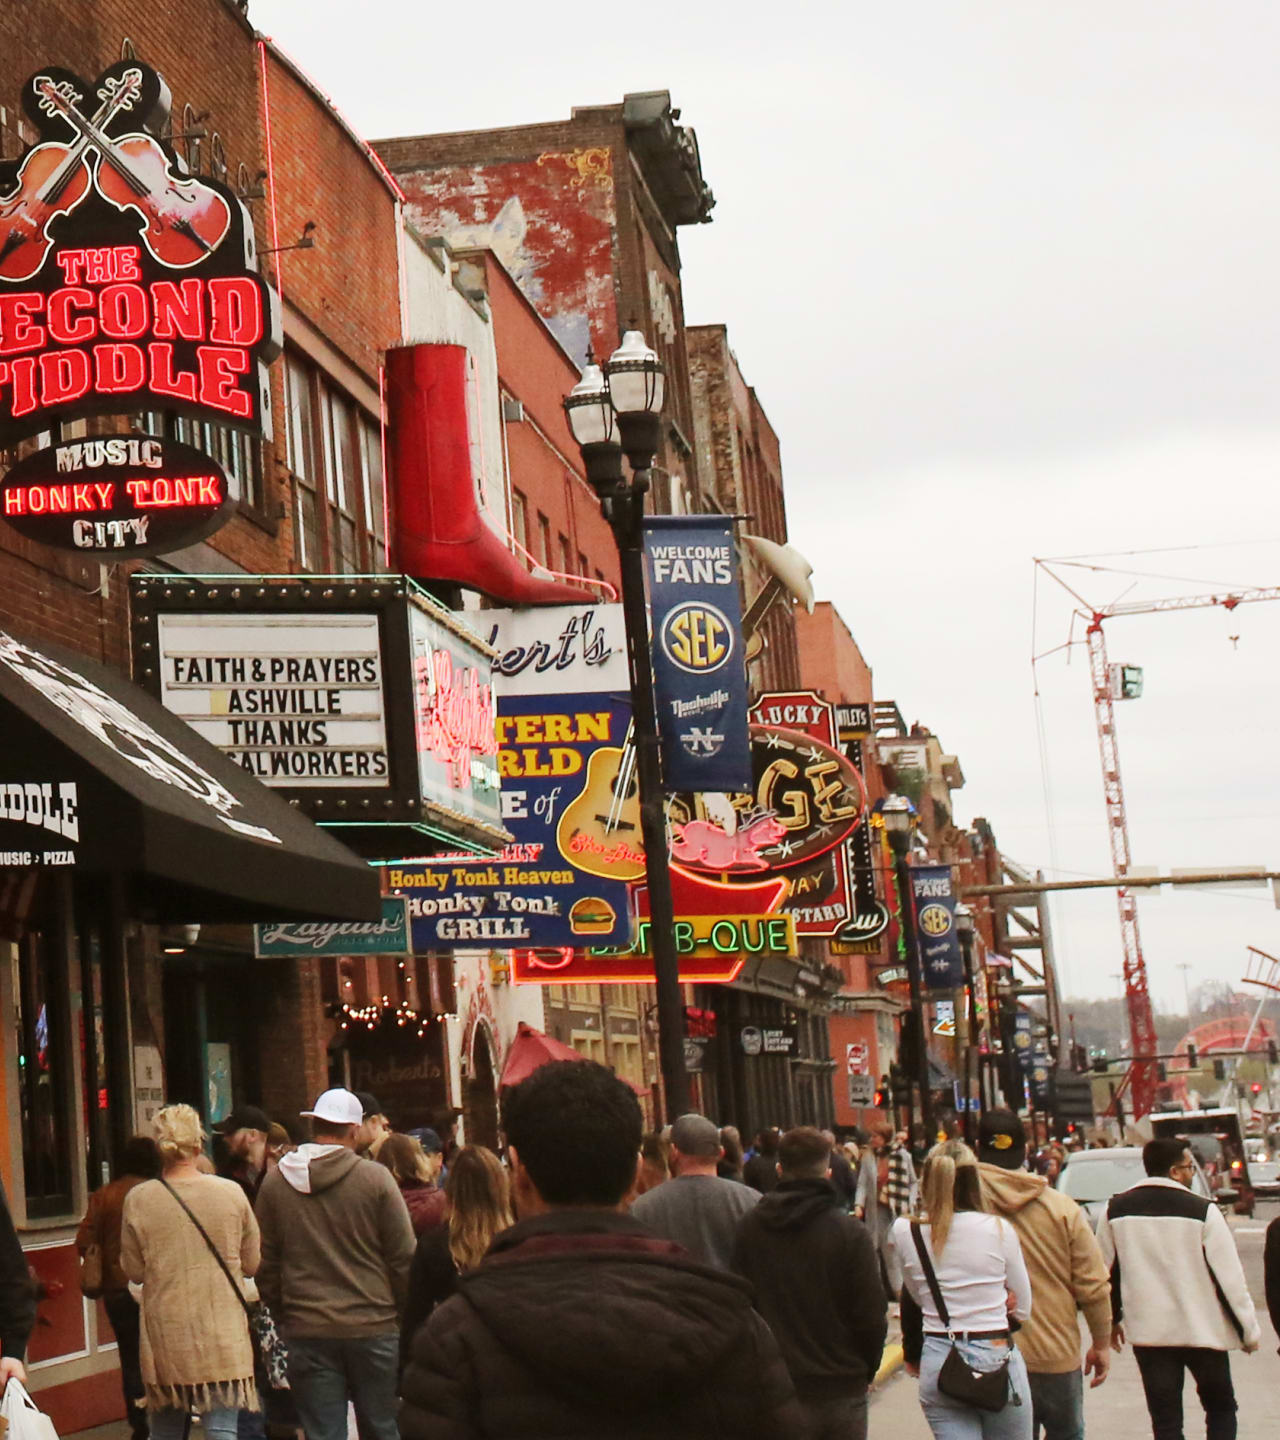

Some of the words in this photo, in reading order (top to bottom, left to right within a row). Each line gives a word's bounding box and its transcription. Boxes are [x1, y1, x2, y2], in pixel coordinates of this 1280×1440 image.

[57, 246, 142, 285] THE
[56, 439, 163, 473] MUSIC
[4, 482, 113, 516] HONKY
[126, 475, 222, 509] TONK
[72, 516, 151, 549] CITY
[651, 546, 730, 560] WELCOME
[654, 560, 732, 585] FANS
[490, 611, 612, 677] ert's
[670, 610, 726, 667] SEC
[174, 658, 246, 683] FAITH
[251, 658, 267, 682] &
[270, 657, 377, 682] PRAYERS
[228, 689, 340, 714] ASHVILLE
[496, 712, 613, 744] TERN
[754, 705, 824, 725] LUCKY
[228, 720, 328, 745] THANKS
[498, 747, 583, 777] RLD
[533, 786, 561, 825] of
[43, 850, 76, 865] PIZZA
[389, 867, 449, 892] Honky
[451, 866, 500, 886] Tonk
[503, 866, 575, 885] Heaven
[494, 891, 561, 917] Tonk
[435, 917, 531, 941] GRILL
[924, 908, 949, 934] SEC
